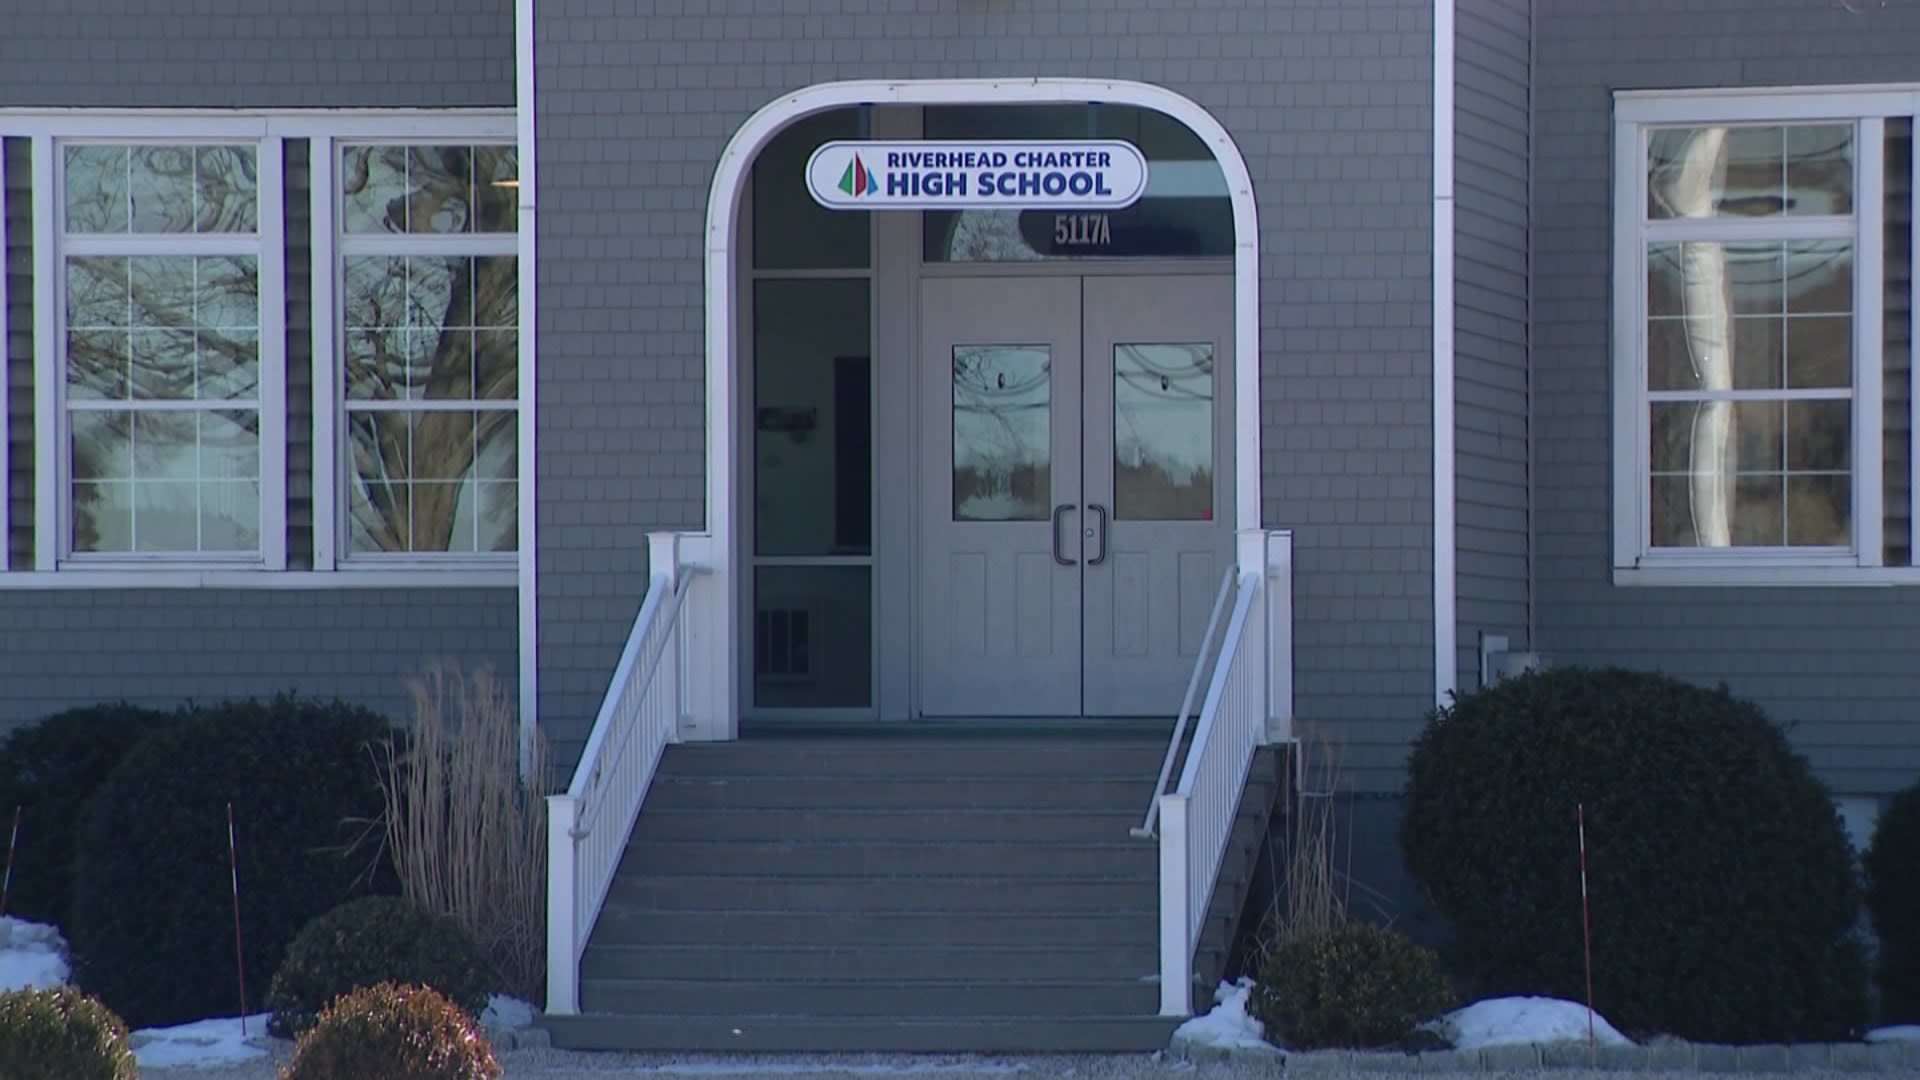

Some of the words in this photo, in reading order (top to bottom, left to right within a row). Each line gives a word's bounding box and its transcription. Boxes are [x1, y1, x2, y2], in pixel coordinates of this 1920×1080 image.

[887, 152, 1007, 168] RIVERHEAD
[1014, 152, 1111, 168] CHARTER
[887, 172, 967, 196] HIGH
[977, 172, 1112, 196] SCHOOL
[1055, 214, 1111, 244] 5117A
